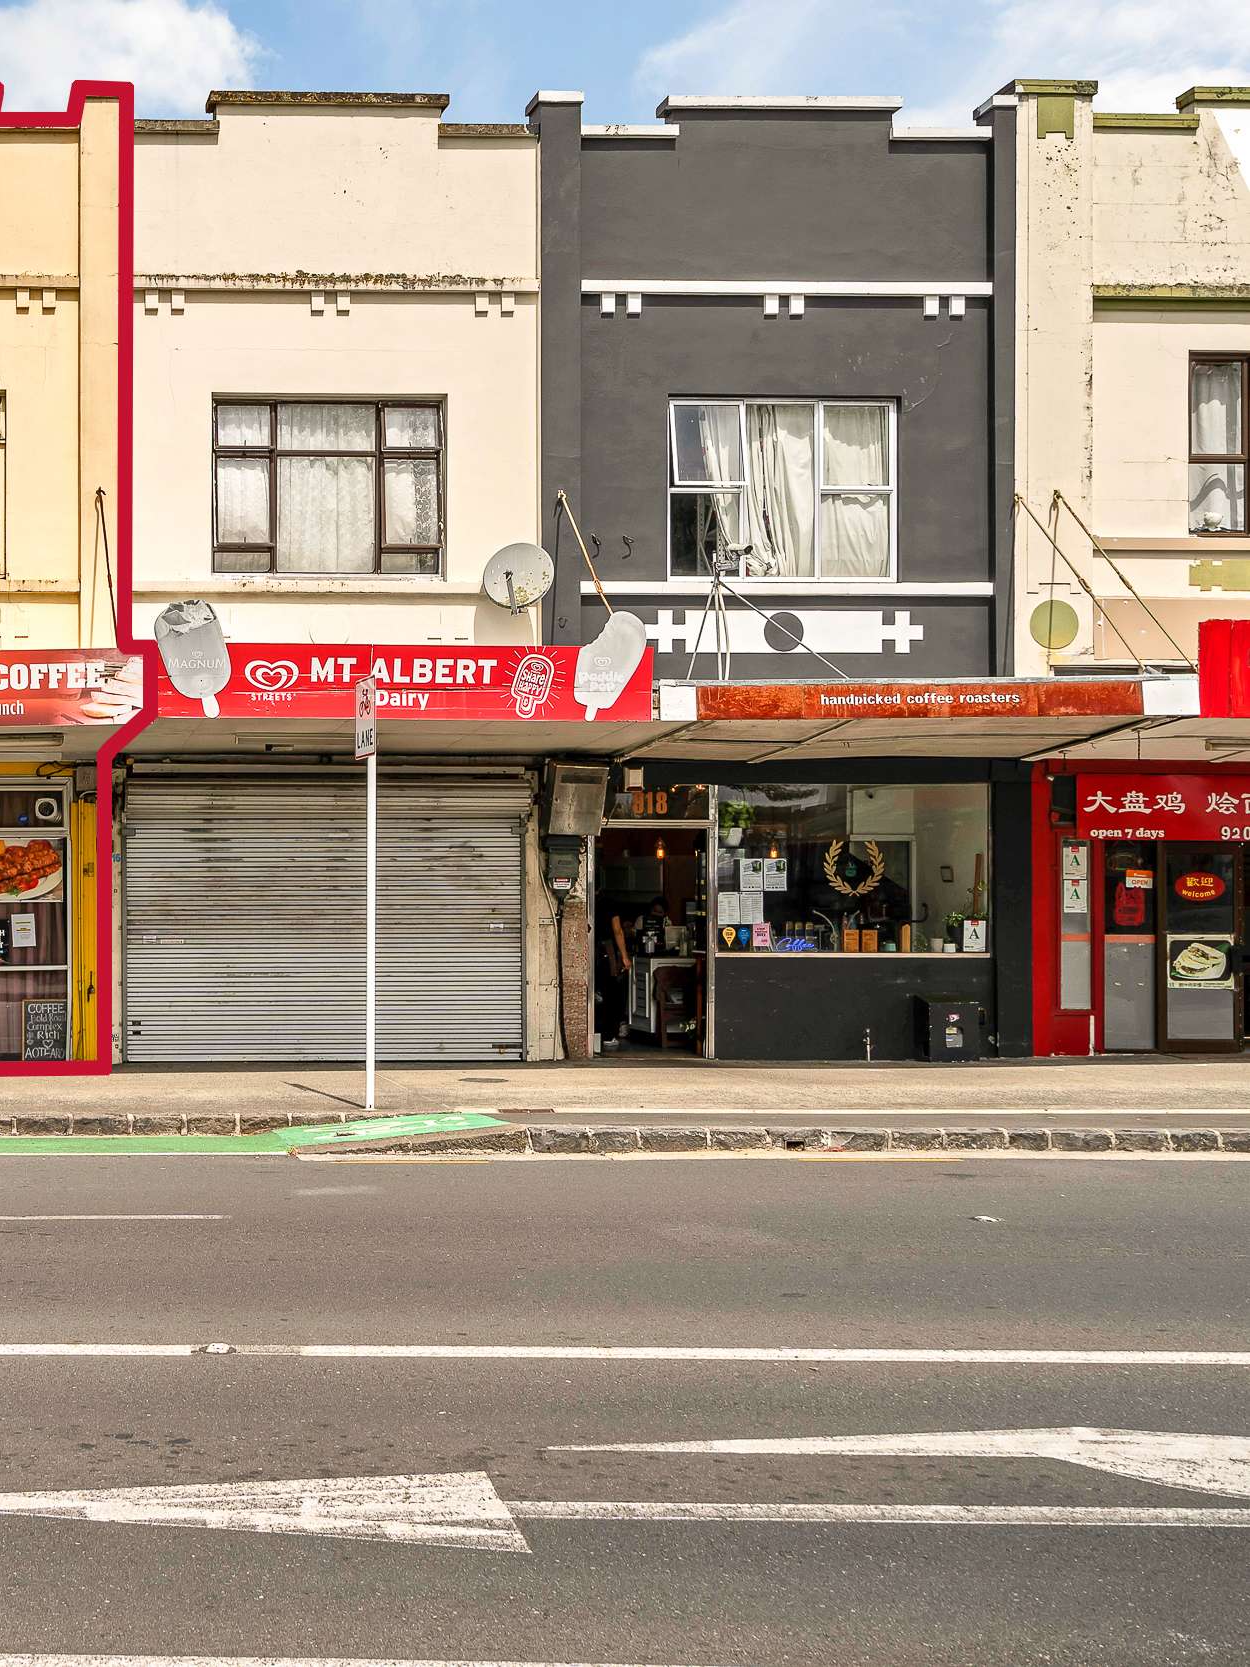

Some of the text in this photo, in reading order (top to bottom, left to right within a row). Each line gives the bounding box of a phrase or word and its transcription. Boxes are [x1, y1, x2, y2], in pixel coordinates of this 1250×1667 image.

[169, 658, 226, 669] MAGNUM
[310, 657, 498, 684] MT ALBERT
[251, 692, 292, 701] STREETS
[375, 689, 429, 710] Dairy
[821, 692, 1020, 705] handpicked coffee roasters
[357, 728, 373, 749] LANE
[1083, 790, 1186, 814] 大盘鸡
[1205, 791, 1250, 814] 烩
[1090, 827, 1165, 839] open 7 days
[1182, 890, 1216, 898] welcome
[969, 927, 979, 940] A
[28, 1003, 64, 1014] COFFEE
[37, 1030, 59, 1040] Rich
